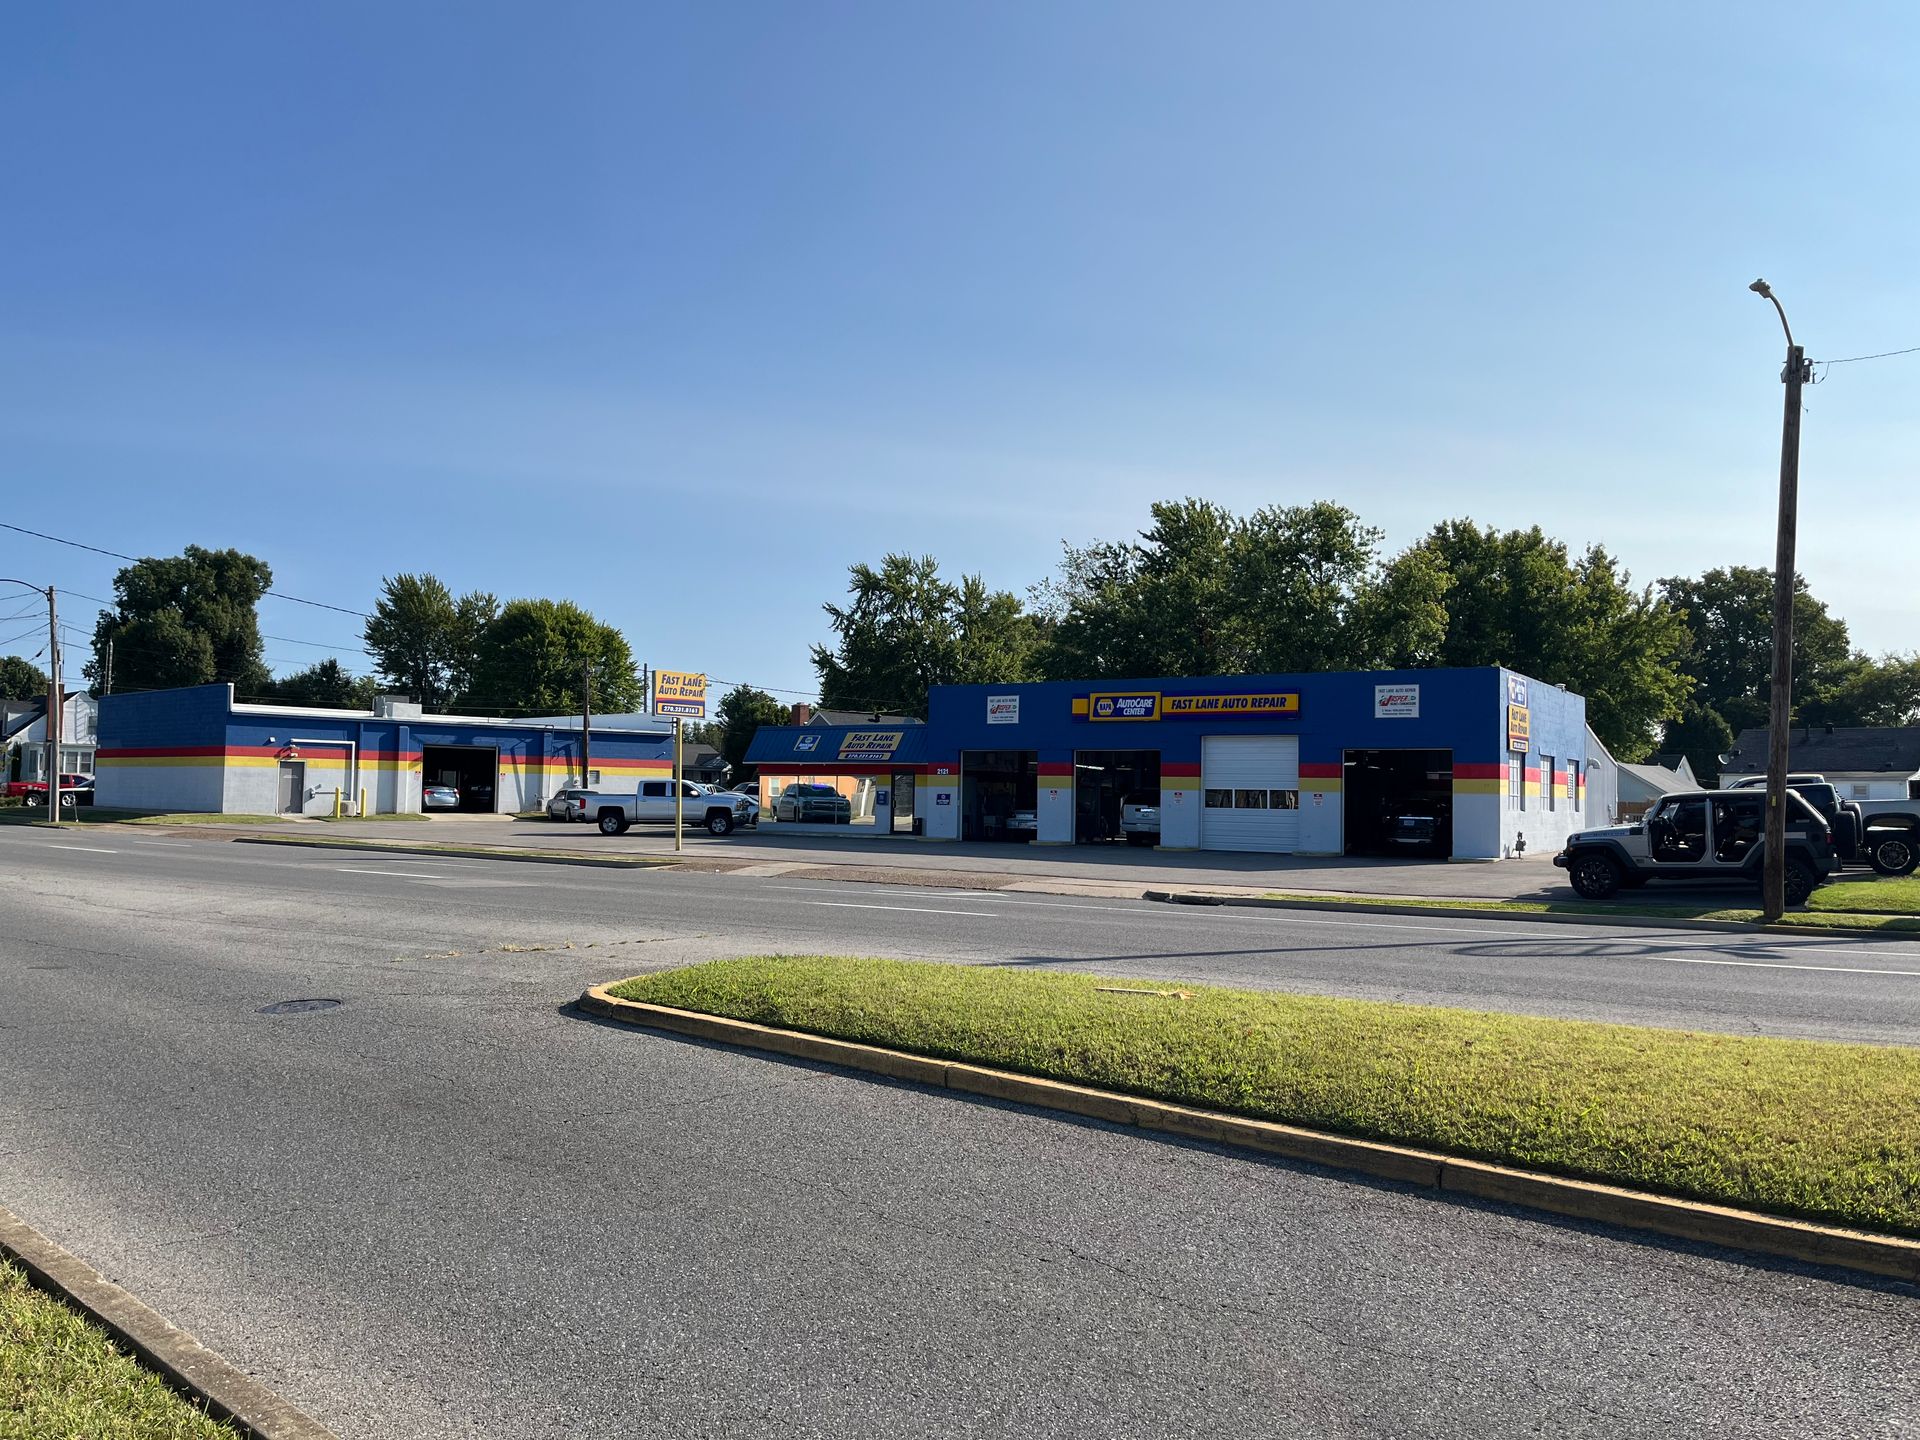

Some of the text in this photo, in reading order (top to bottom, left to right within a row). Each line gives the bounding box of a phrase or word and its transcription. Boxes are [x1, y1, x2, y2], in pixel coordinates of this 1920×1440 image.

[662, 674, 702, 687] FAST LANE
[658, 685, 703, 697] AUTO REPAIR
[1171, 697, 1287, 710] FAST LANE AUTO REPAIR
[1123, 708, 1146, 716] CENTER
[851, 733, 897, 742] FAST LANE
[866, 742, 893, 750] REPAIR
